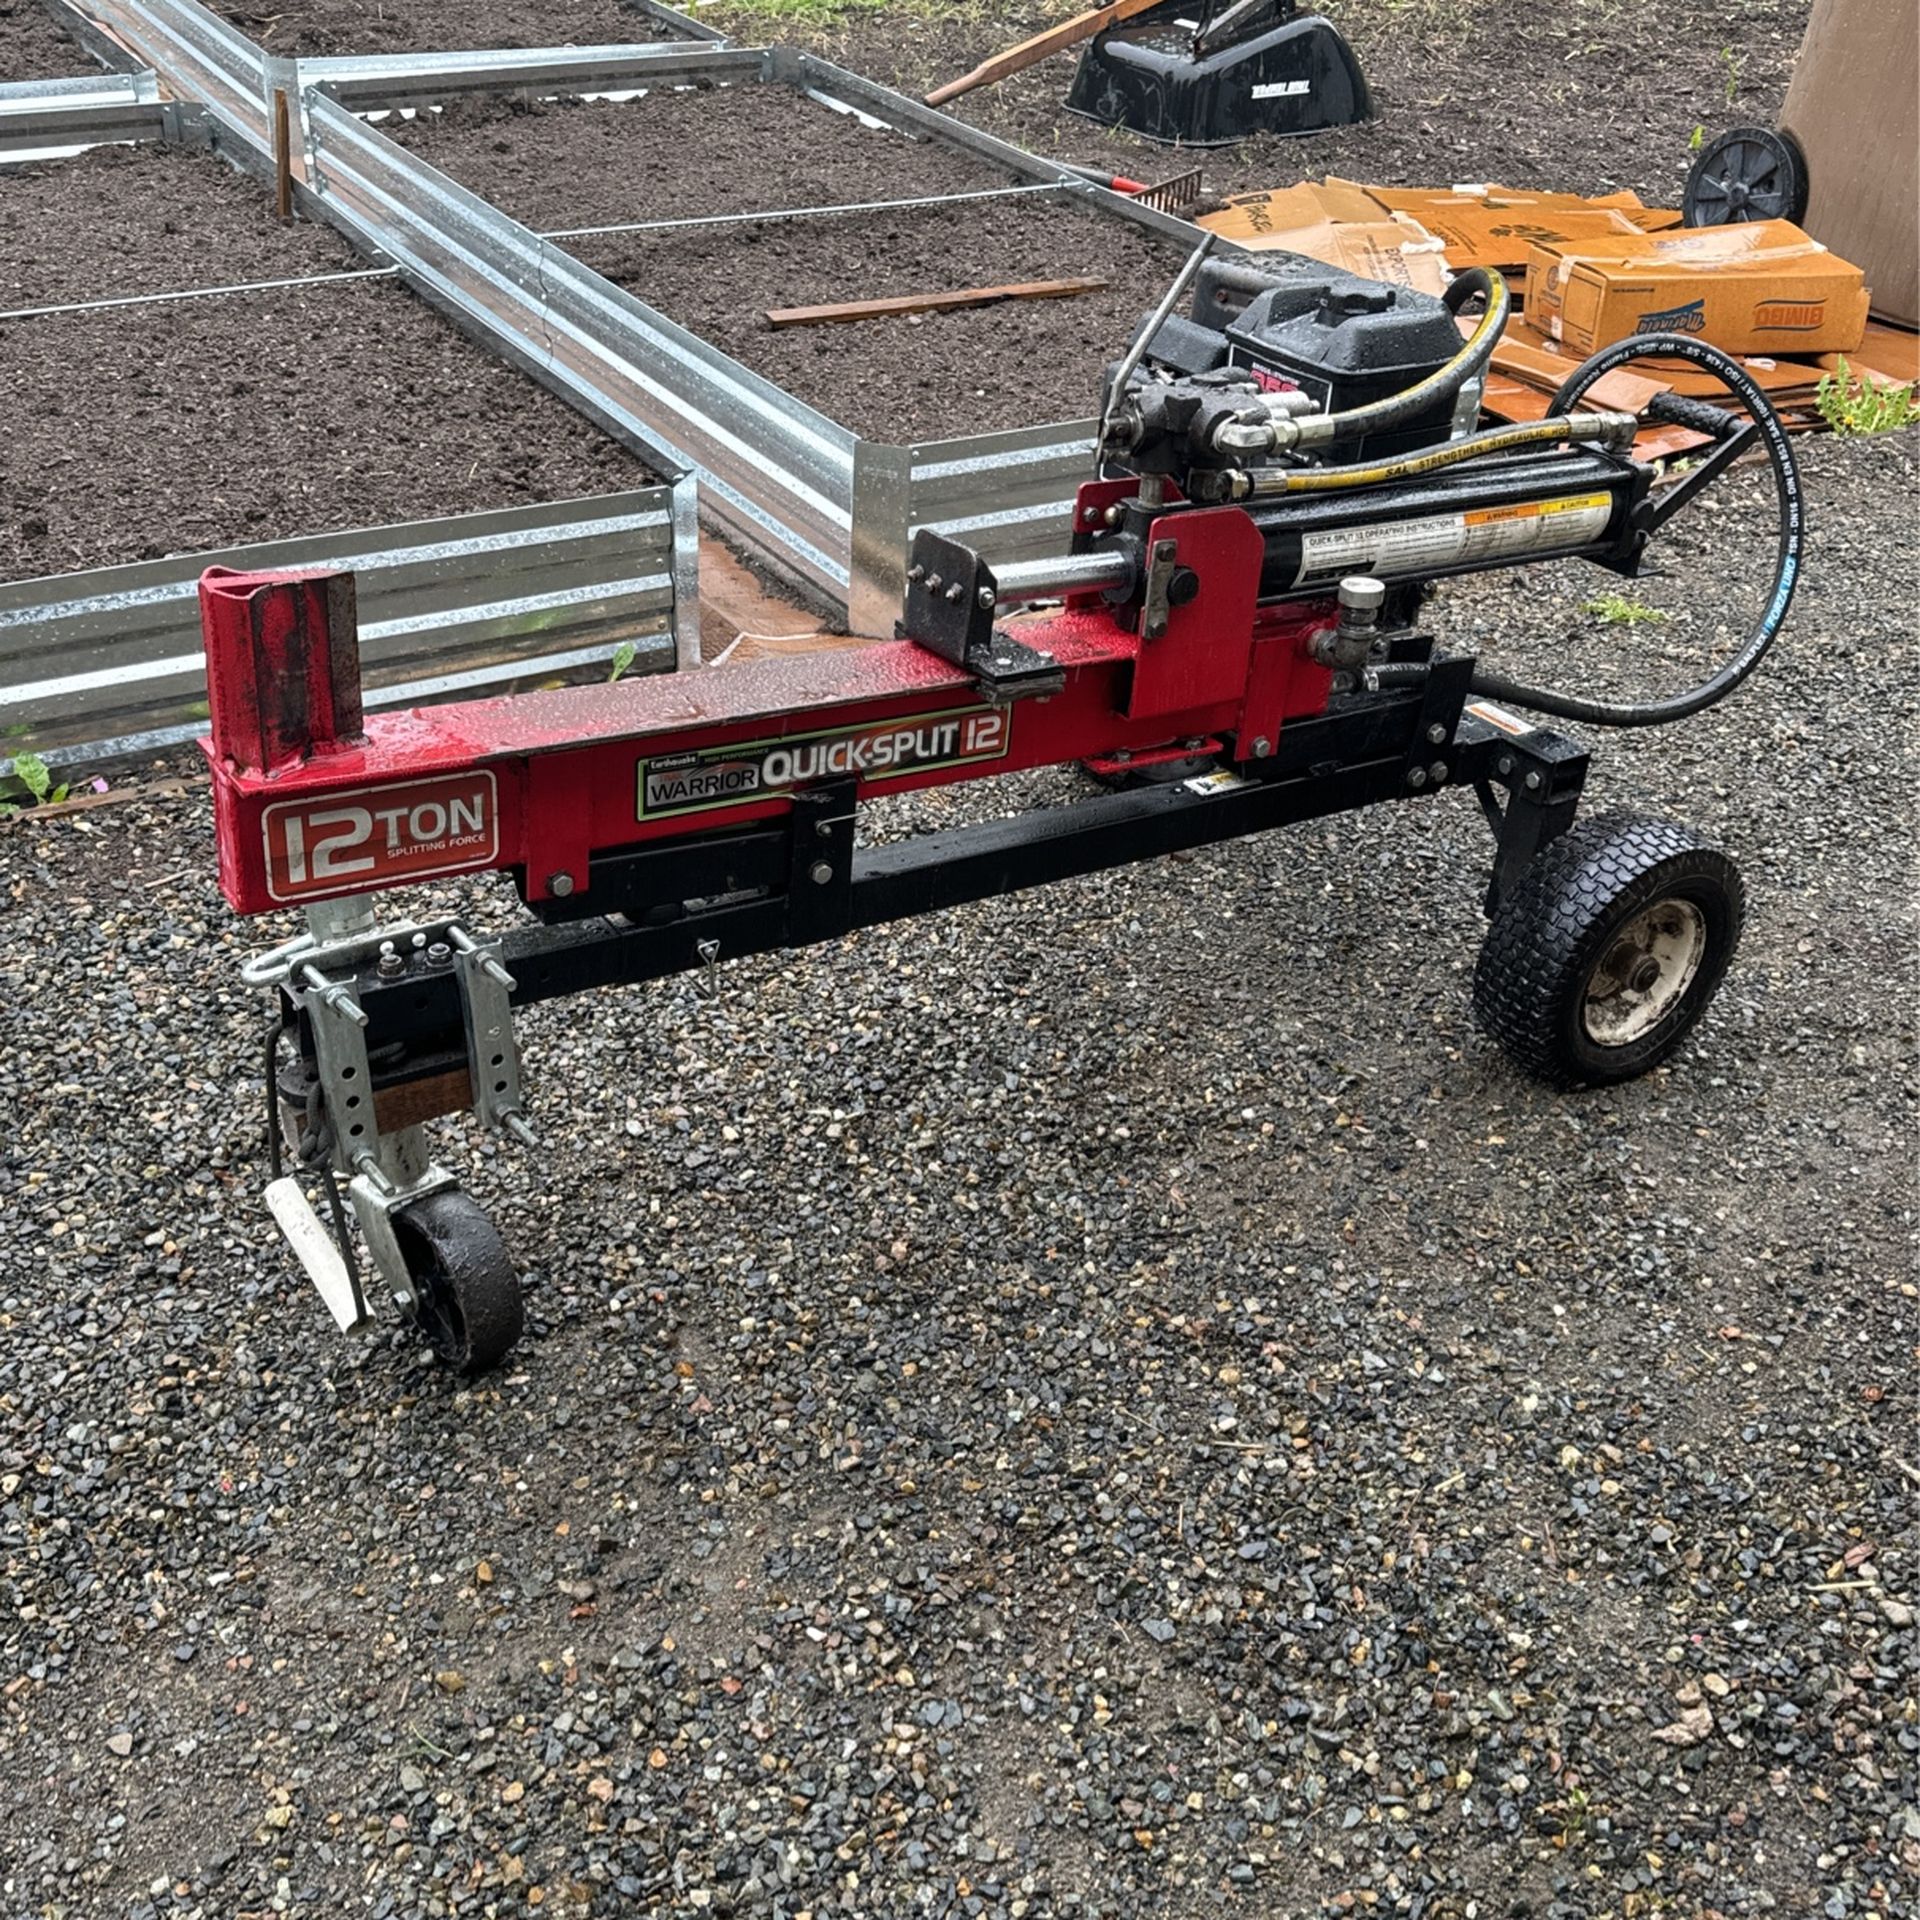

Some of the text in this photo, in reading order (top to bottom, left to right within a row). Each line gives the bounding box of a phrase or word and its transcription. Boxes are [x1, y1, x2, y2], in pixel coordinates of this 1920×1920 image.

[1755, 306, 1824, 326] BIMBO
[1725, 367, 1741, 381] ISO
[1766, 418, 1780, 438] SAE
[1418, 444, 1484, 469] STRENGTHEN
[1489, 430, 1546, 447] HYDRAULIC
[1783, 461, 1793, 475] EN
[1787, 477, 1796, 495] DIN
[1781, 557, 1795, 586] UNO
[1765, 588, 1789, 626] FORZA
[651, 715, 1002, 801] WARRIOR QUICK-SPLIT 12
[285, 793, 484, 884] 12 TON
[387, 832, 487, 859] SPLITTING FORCE
